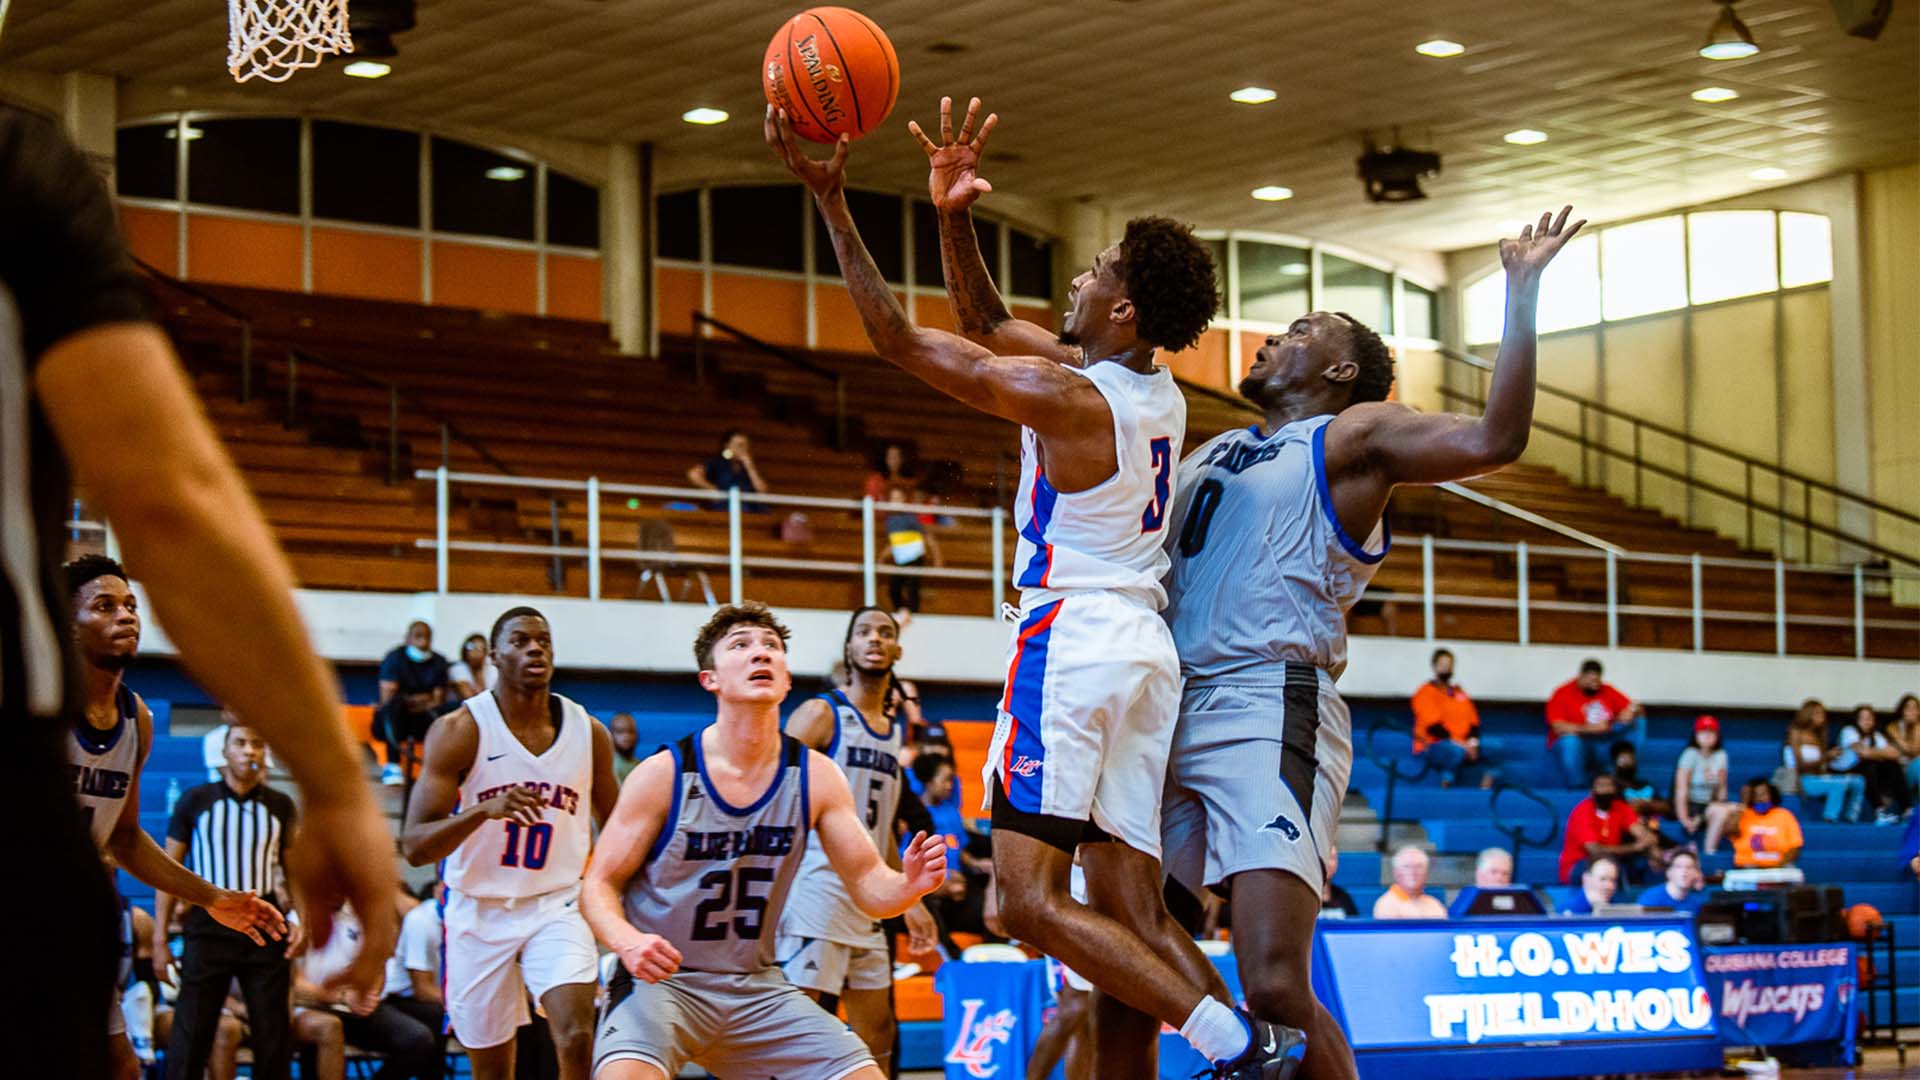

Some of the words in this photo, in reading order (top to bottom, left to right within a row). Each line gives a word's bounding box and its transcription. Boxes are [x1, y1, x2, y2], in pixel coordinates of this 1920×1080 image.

[795, 34, 846, 123] SPALDING
[1141, 435, 1171, 535] 3
[1179, 477, 1225, 558] 0
[865, 779, 884, 831] 5
[499, 819, 554, 870] 10
[690, 869, 775, 941] 25
[1778, 948, 1849, 968] COLLEGE
